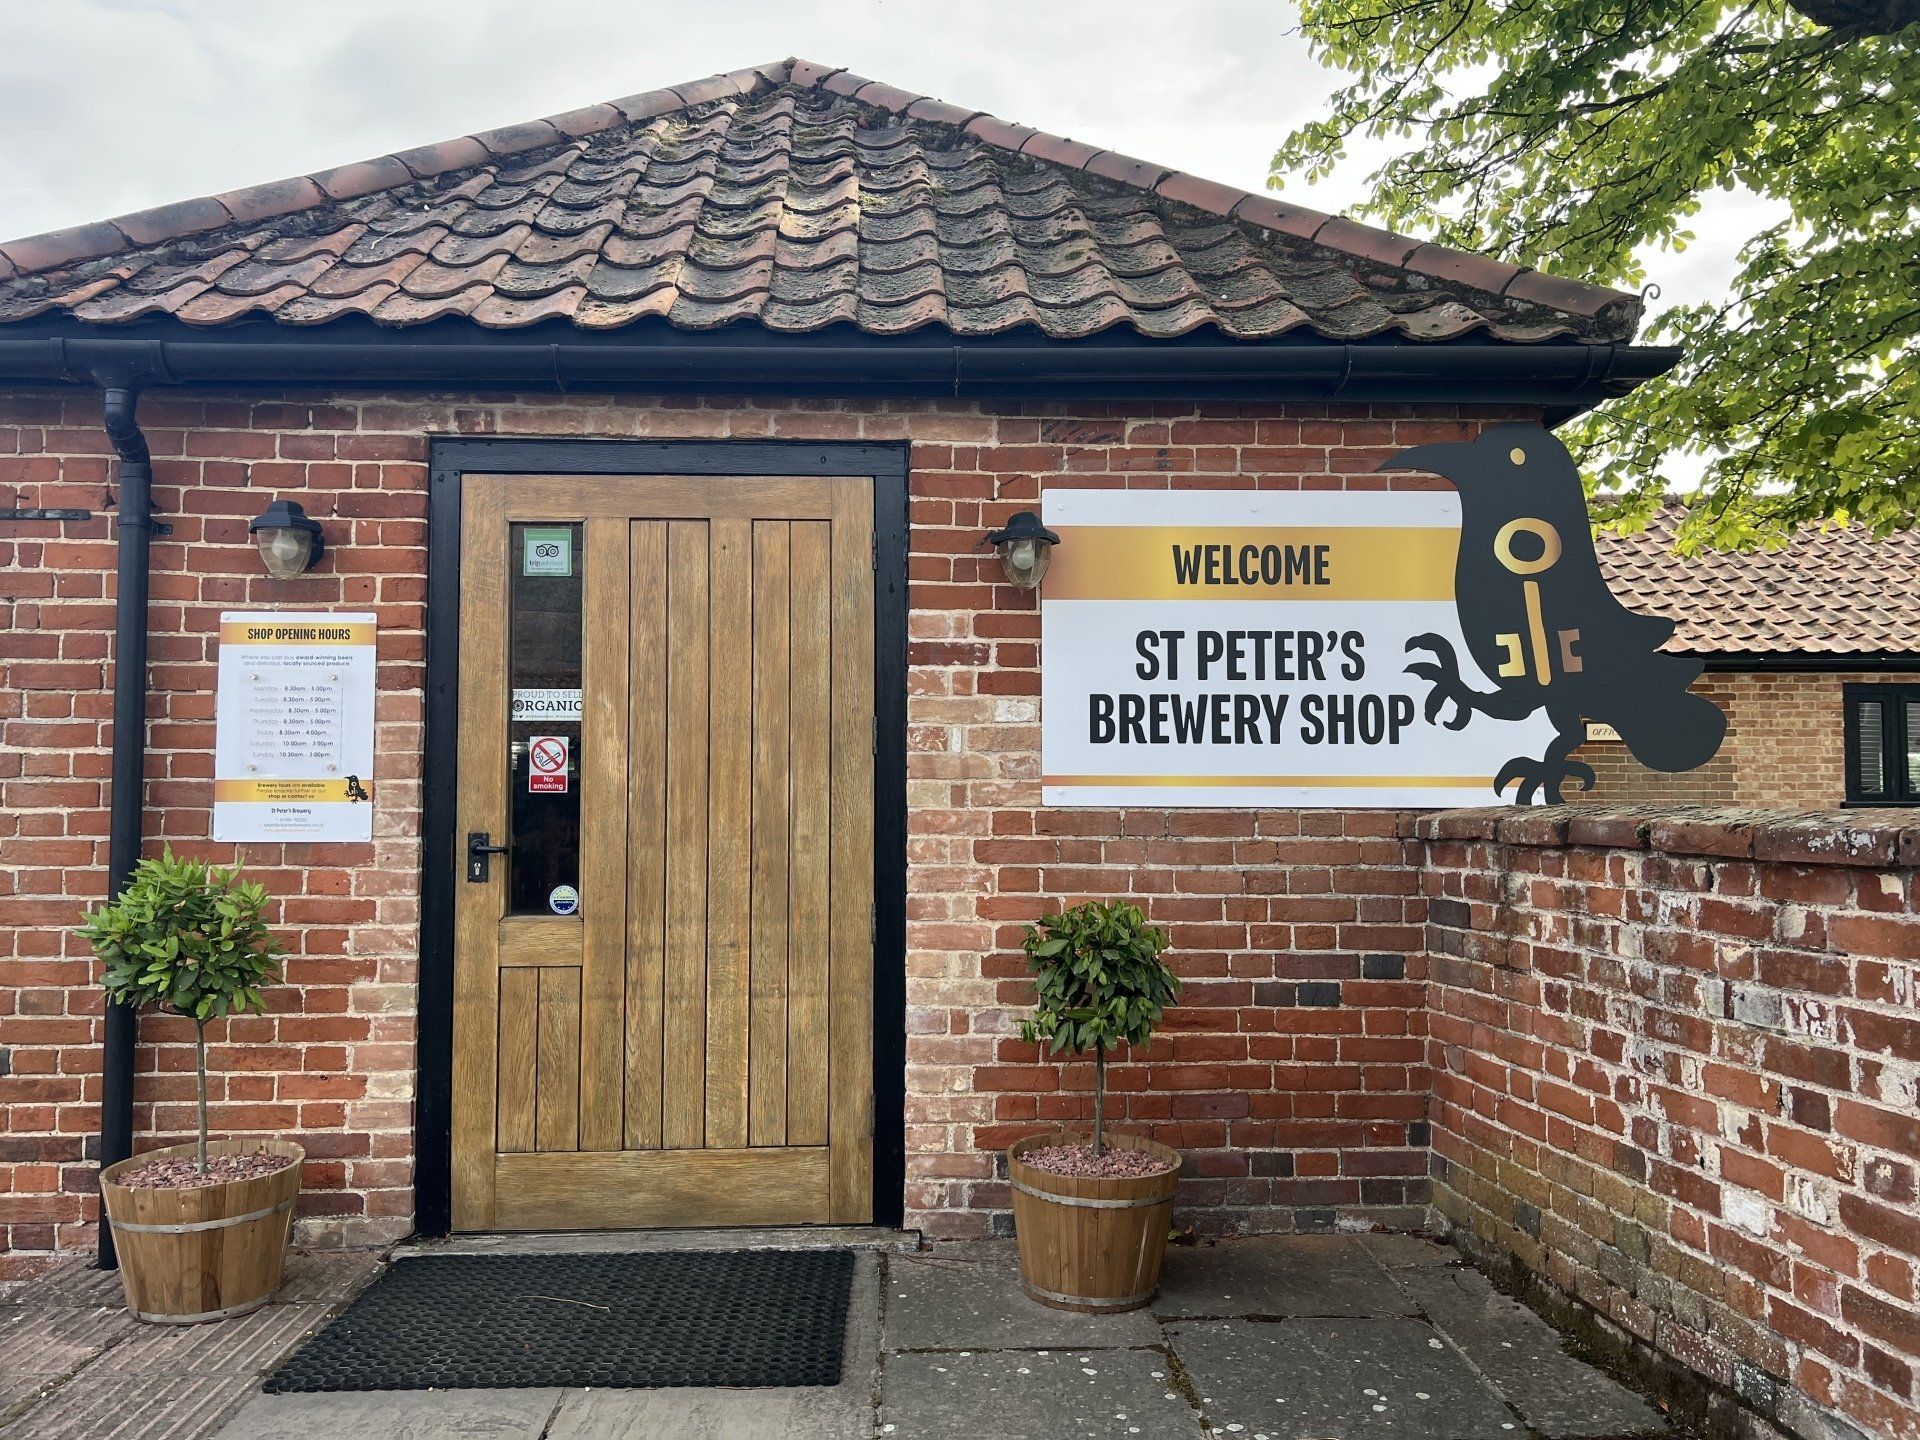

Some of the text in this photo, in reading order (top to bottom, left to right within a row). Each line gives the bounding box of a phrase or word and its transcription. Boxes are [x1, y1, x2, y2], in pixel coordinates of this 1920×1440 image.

[1172, 544, 1330, 585] WELCOME
[248, 628, 350, 640] SHOP OPENING HOURS
[1135, 630, 1365, 681] ST PETER'S
[512, 700, 582, 712] ORGANIC
[513, 690, 582, 698] PROUD TO SELL
[1089, 694, 1415, 745] BREWERY SHOP
